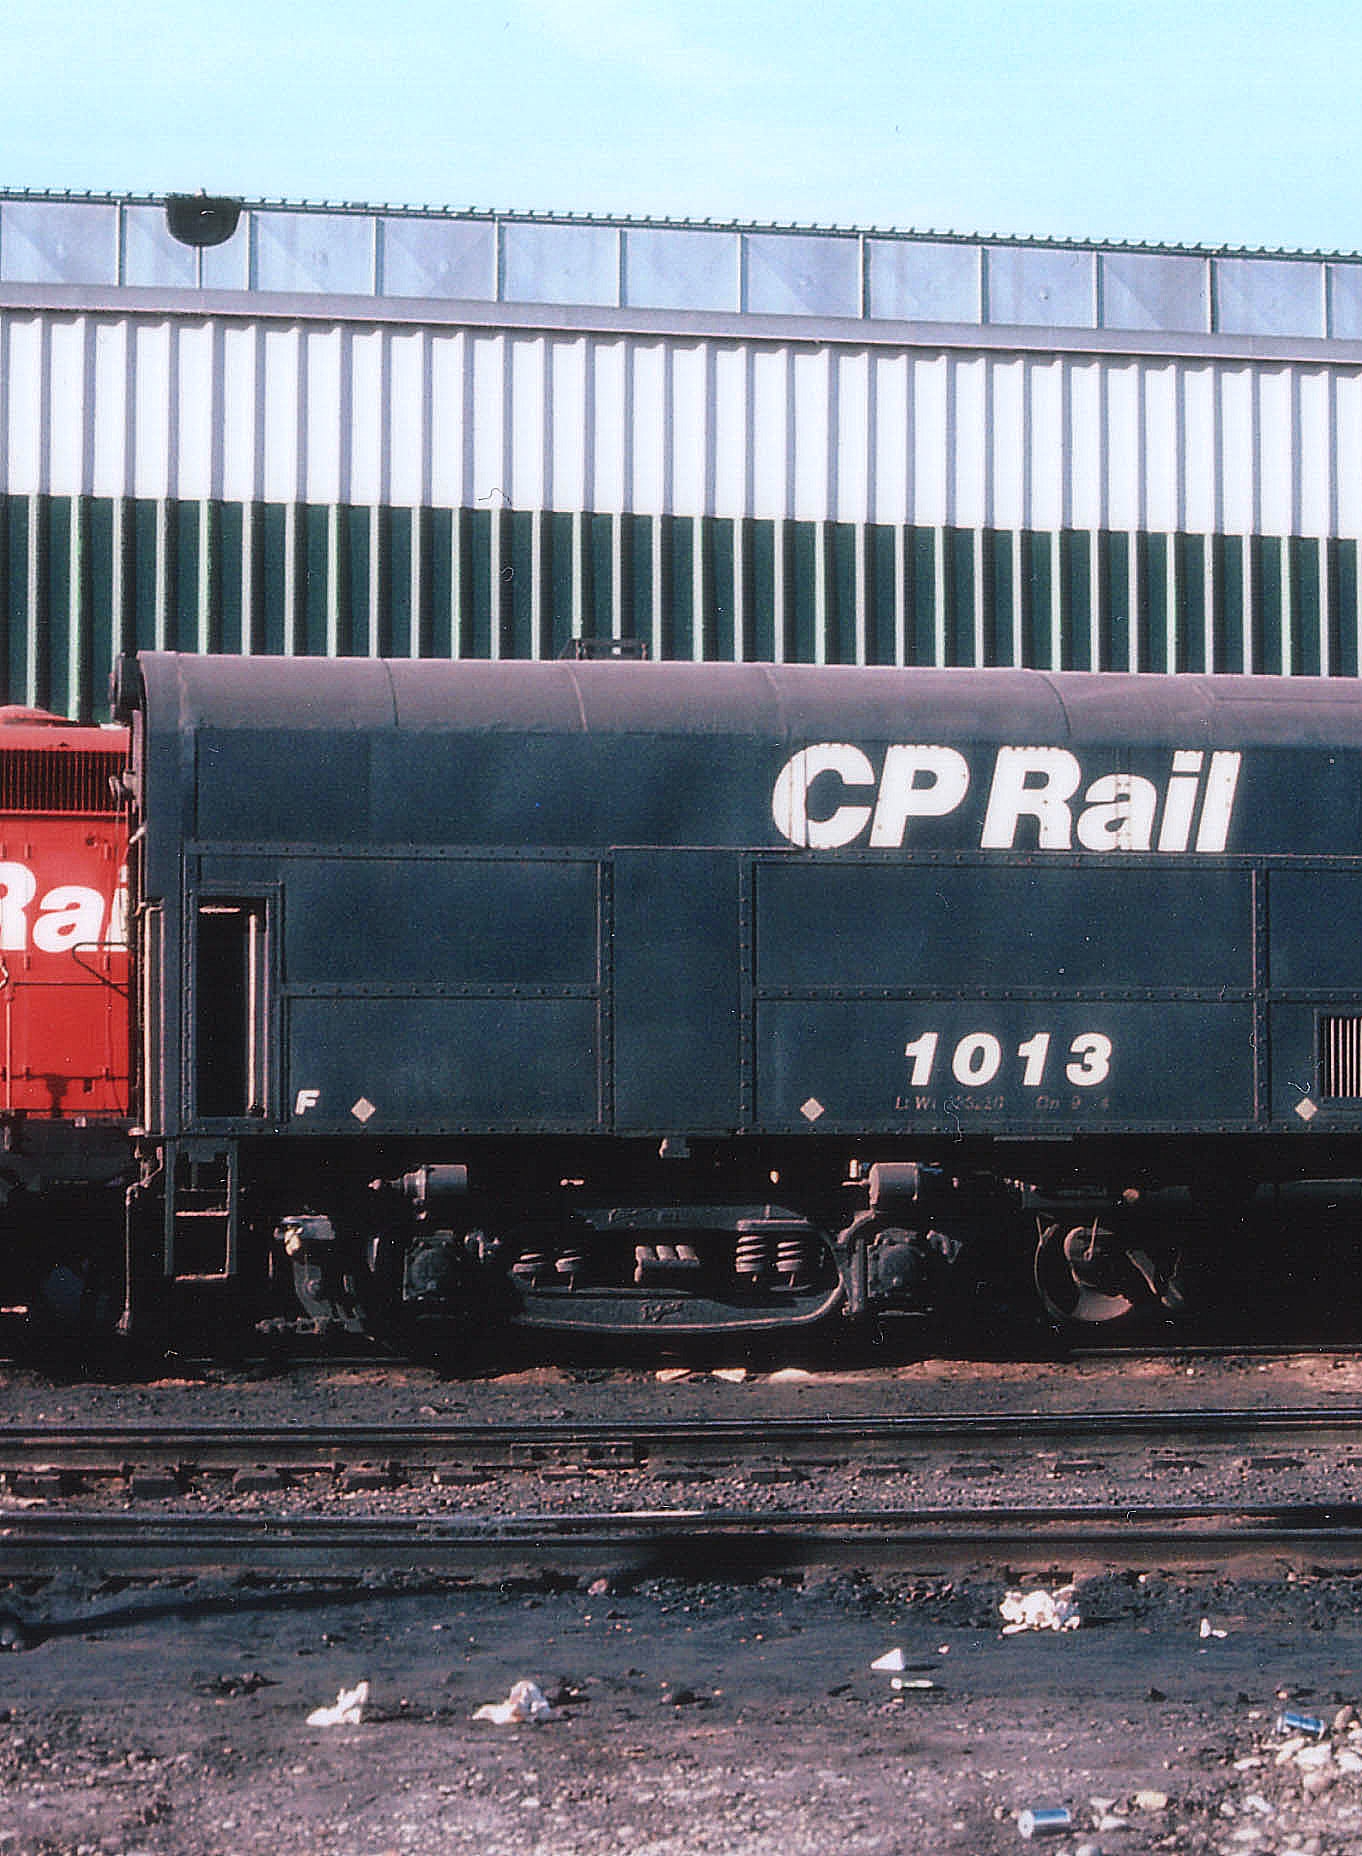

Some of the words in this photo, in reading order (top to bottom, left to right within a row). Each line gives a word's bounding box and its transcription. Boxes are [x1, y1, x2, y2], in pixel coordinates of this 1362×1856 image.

[771, 742, 970, 850] CP
[980, 745, 1242, 853] Rail
[904, 1032, 1112, 1087] 1013
[295, 1089, 320, 1115] F
